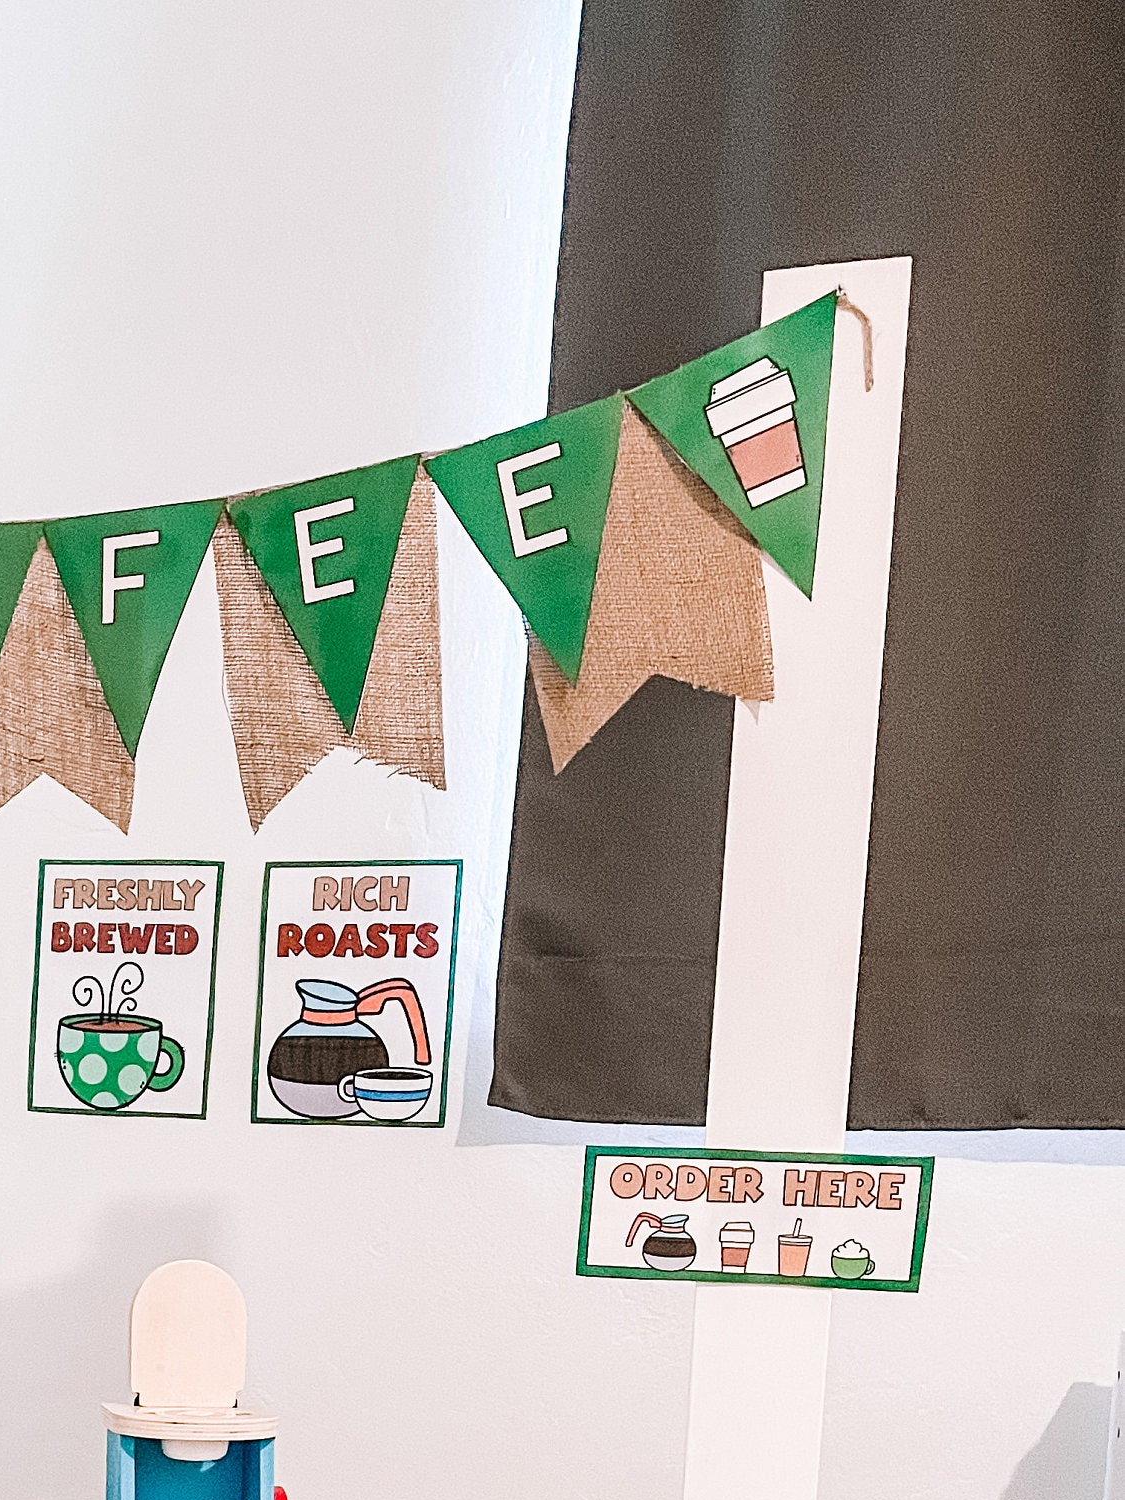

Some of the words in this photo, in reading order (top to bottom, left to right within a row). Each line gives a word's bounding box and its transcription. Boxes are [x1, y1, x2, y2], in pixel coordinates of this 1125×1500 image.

[53, 878, 206, 912] FRESHLY
[312, 875, 410, 912] RICH
[51, 921, 199, 956] BREWED
[276, 922, 440, 959] ROASTS
[610, 1162, 764, 1203] ORDER
[783, 1169, 905, 1210] HERE
